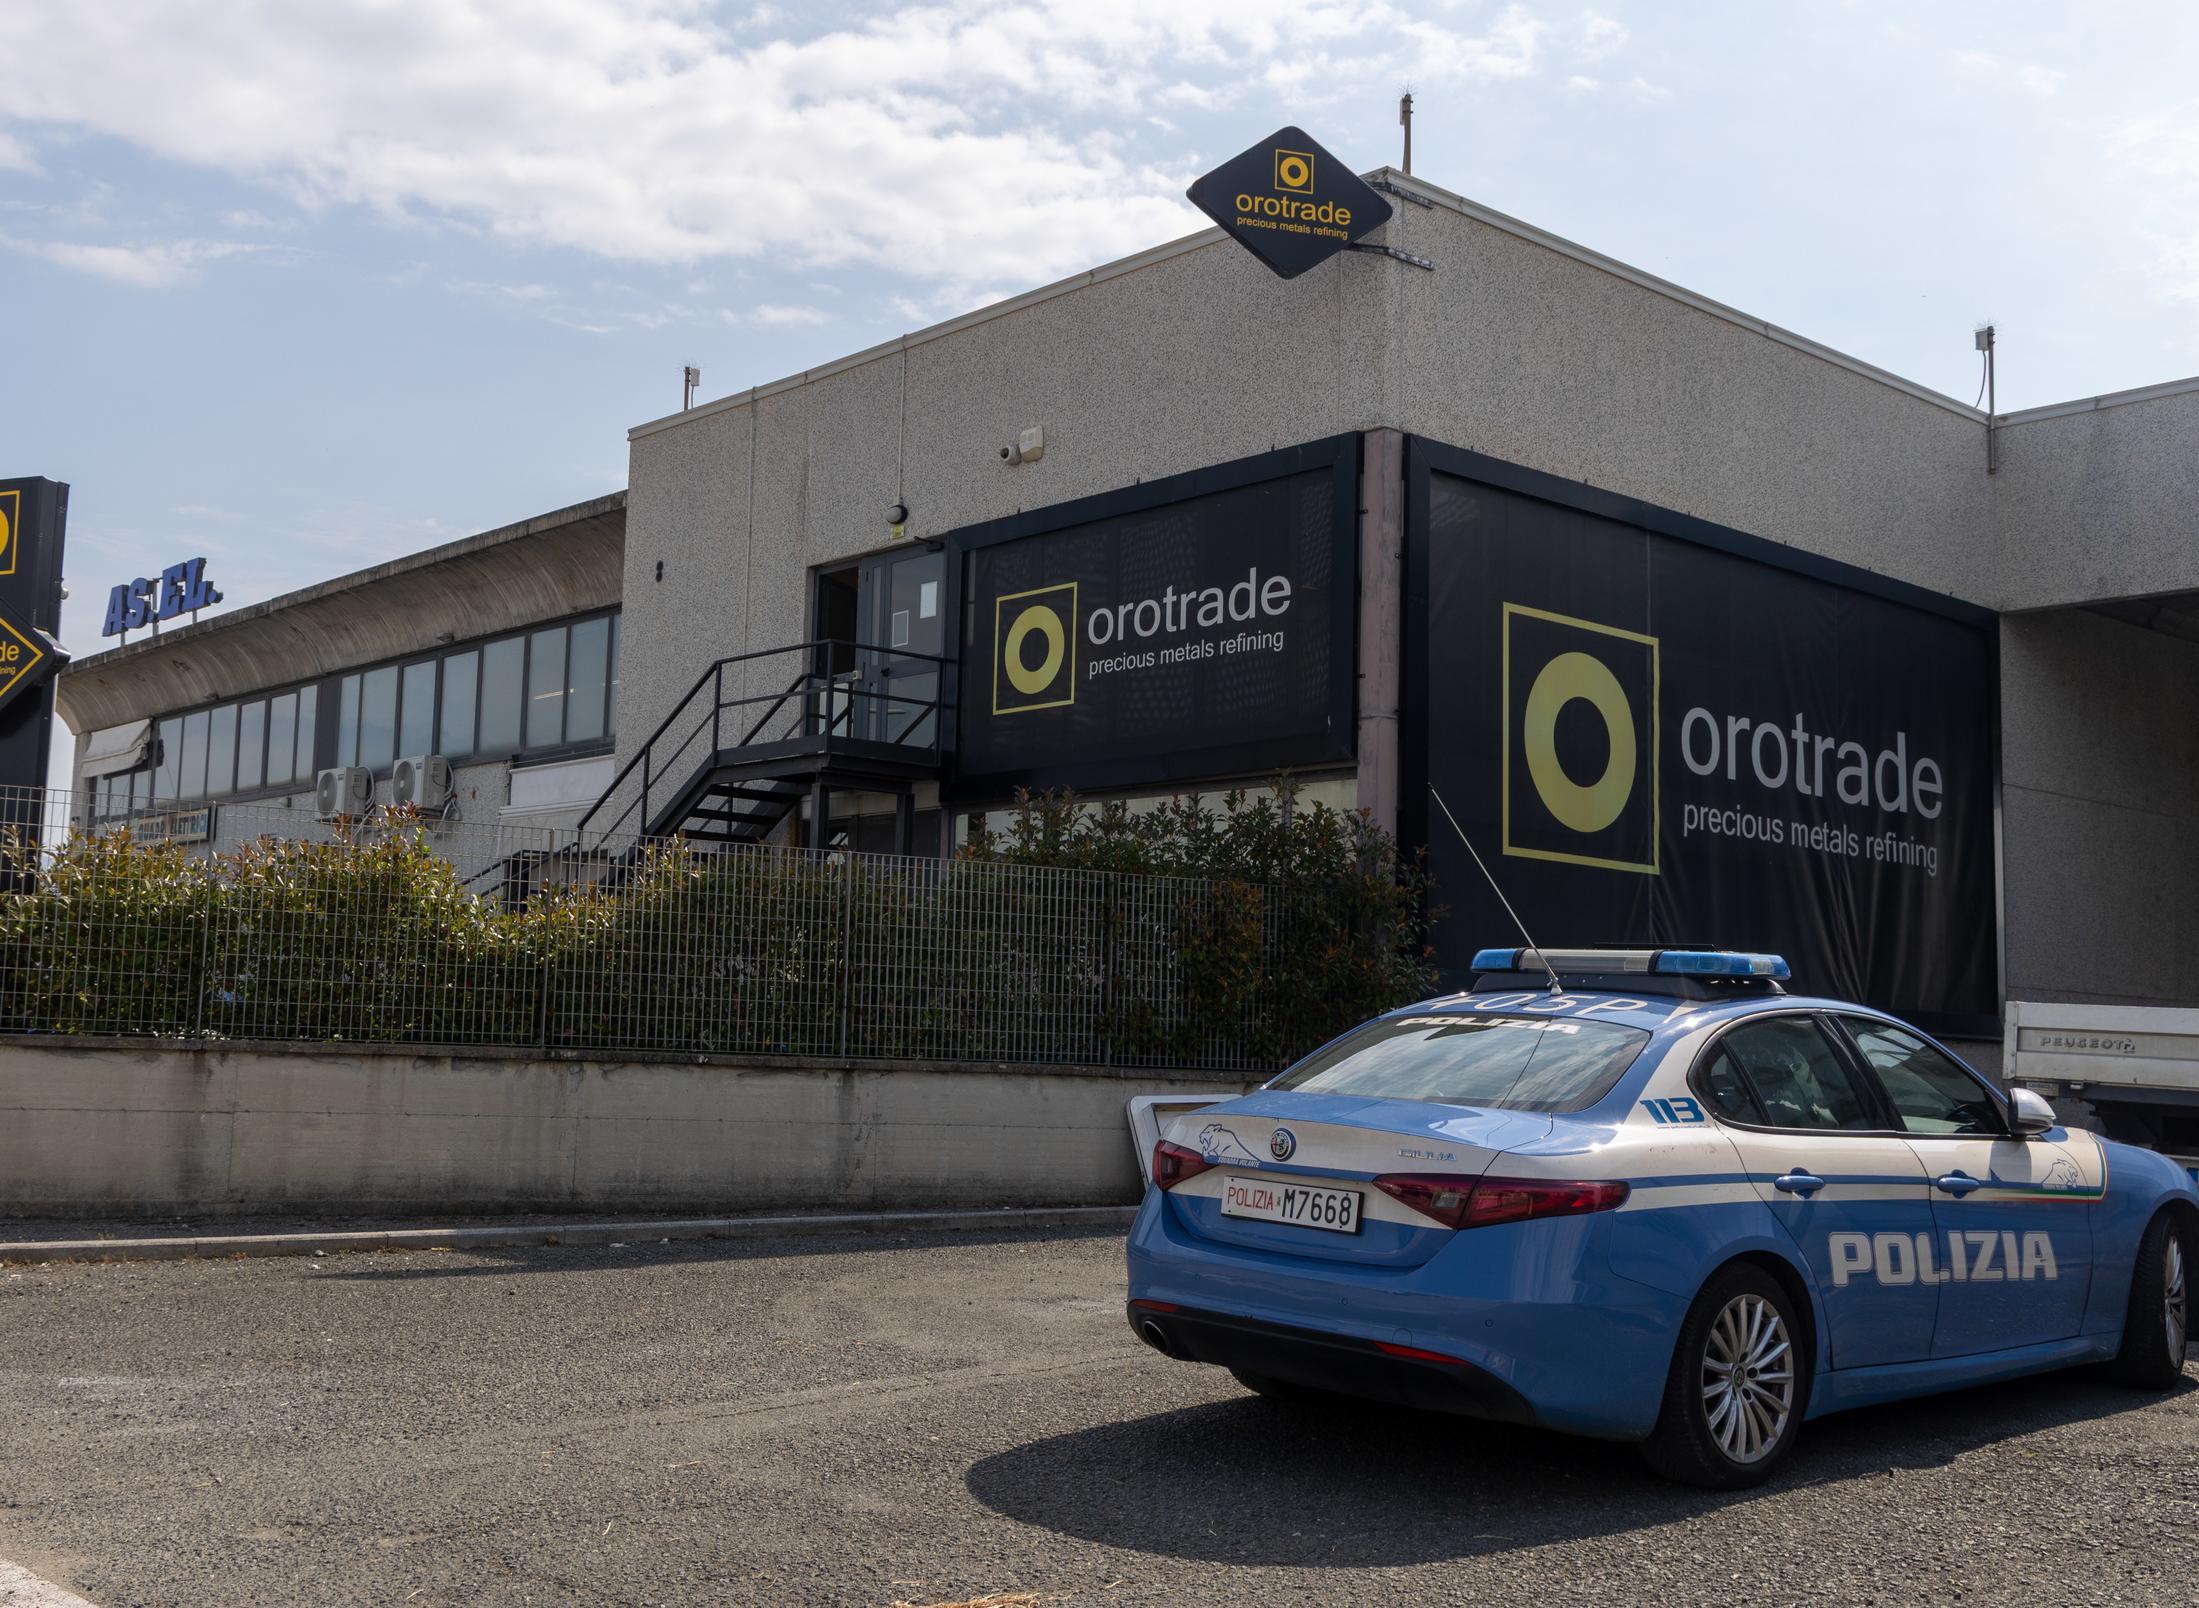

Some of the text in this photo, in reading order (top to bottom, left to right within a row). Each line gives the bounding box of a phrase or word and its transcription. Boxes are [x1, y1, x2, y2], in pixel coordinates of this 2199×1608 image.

[1236, 194, 1351, 225] orotrade
[1237, 216, 1348, 240] precious metals refining
[102, 557, 223, 637] AS.EL.
[1087, 566, 1292, 645] orotrade
[1088, 630, 1285, 680] precious metals refining
[1680, 706, 1944, 820] orotrade
[1683, 803, 1938, 878] precious metals refining
[1395, 1016, 1582, 1036] POLIZIA
[2040, 1036, 2124, 1050] PEUGEOT
[1639, 1096, 1705, 1124] 113
[1227, 1186, 1353, 1227] POLIZIA M7668
[1828, 1231, 2059, 1288] POLIZIA
